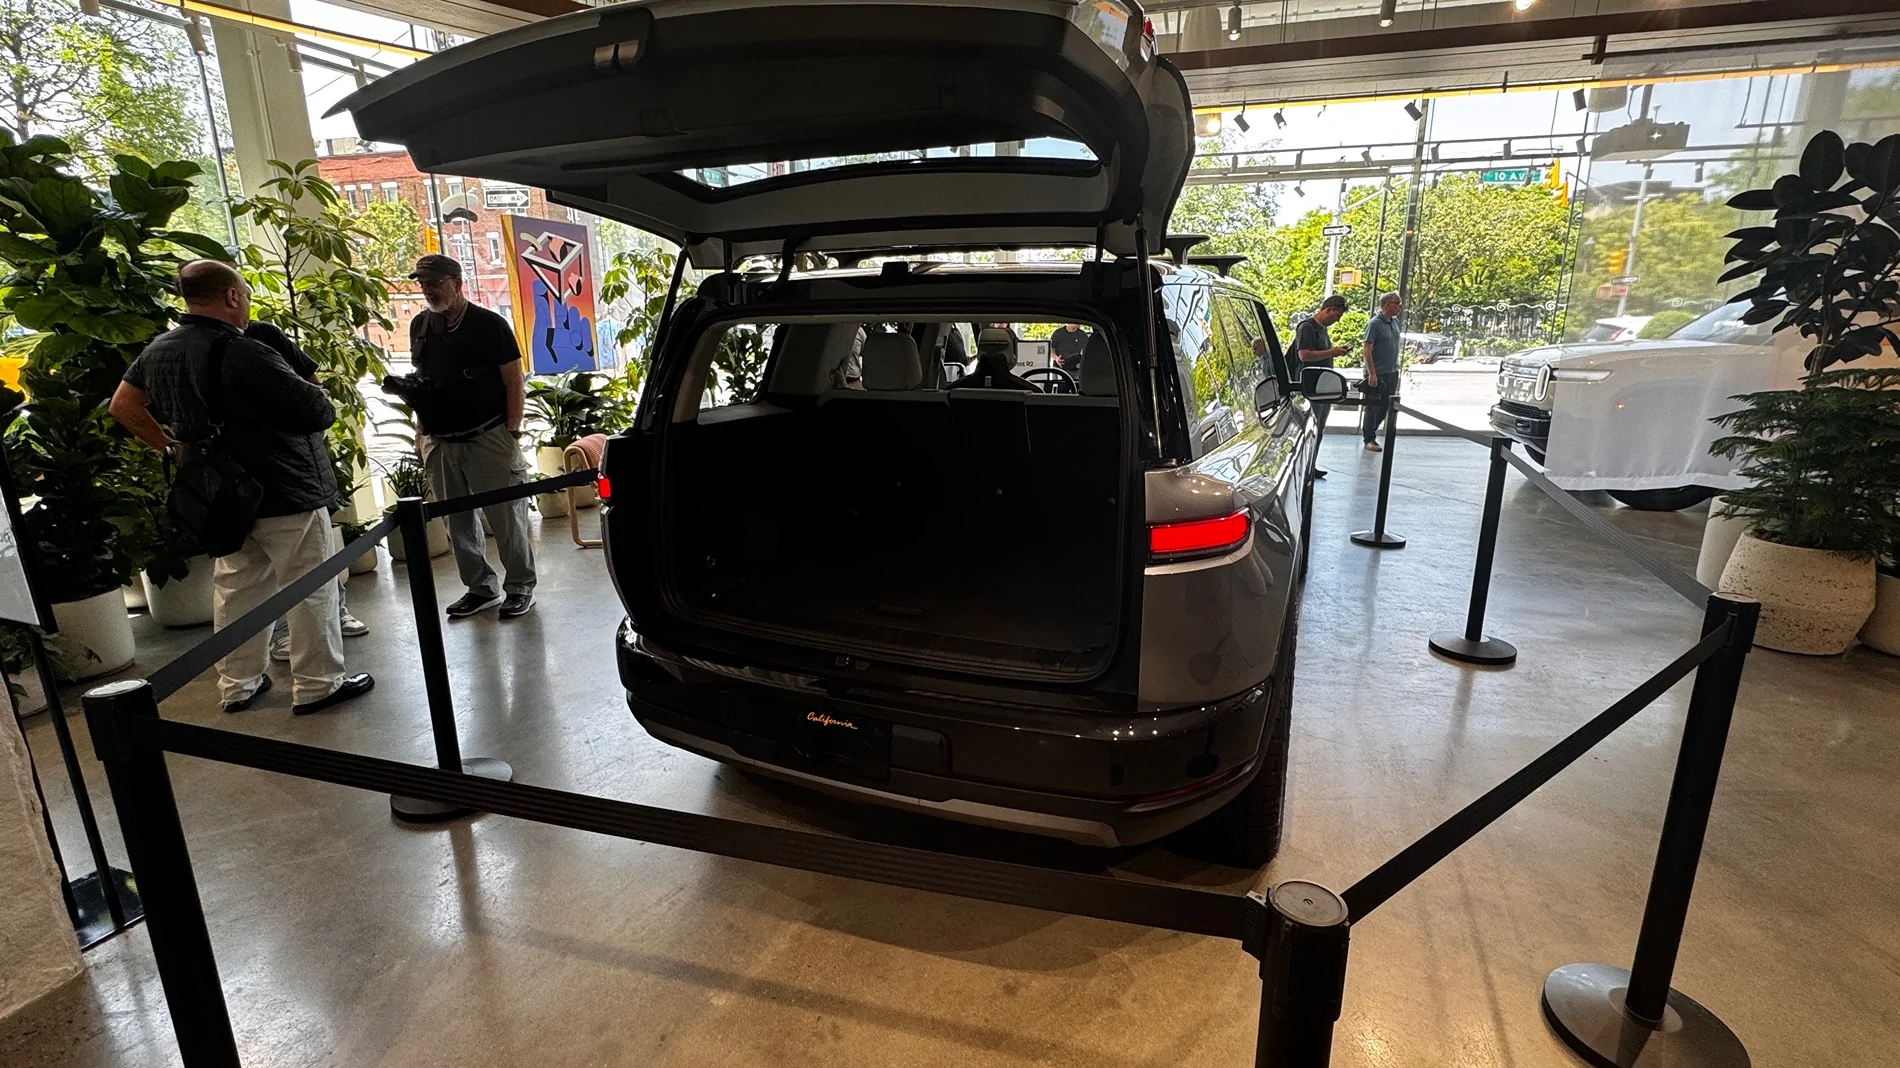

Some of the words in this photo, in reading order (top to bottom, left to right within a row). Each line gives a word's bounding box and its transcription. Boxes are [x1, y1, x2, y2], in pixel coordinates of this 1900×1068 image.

[1494, 172, 1506, 181] 10
[489, 195, 503, 203] ONE
[806, 711, 858, 730] California
